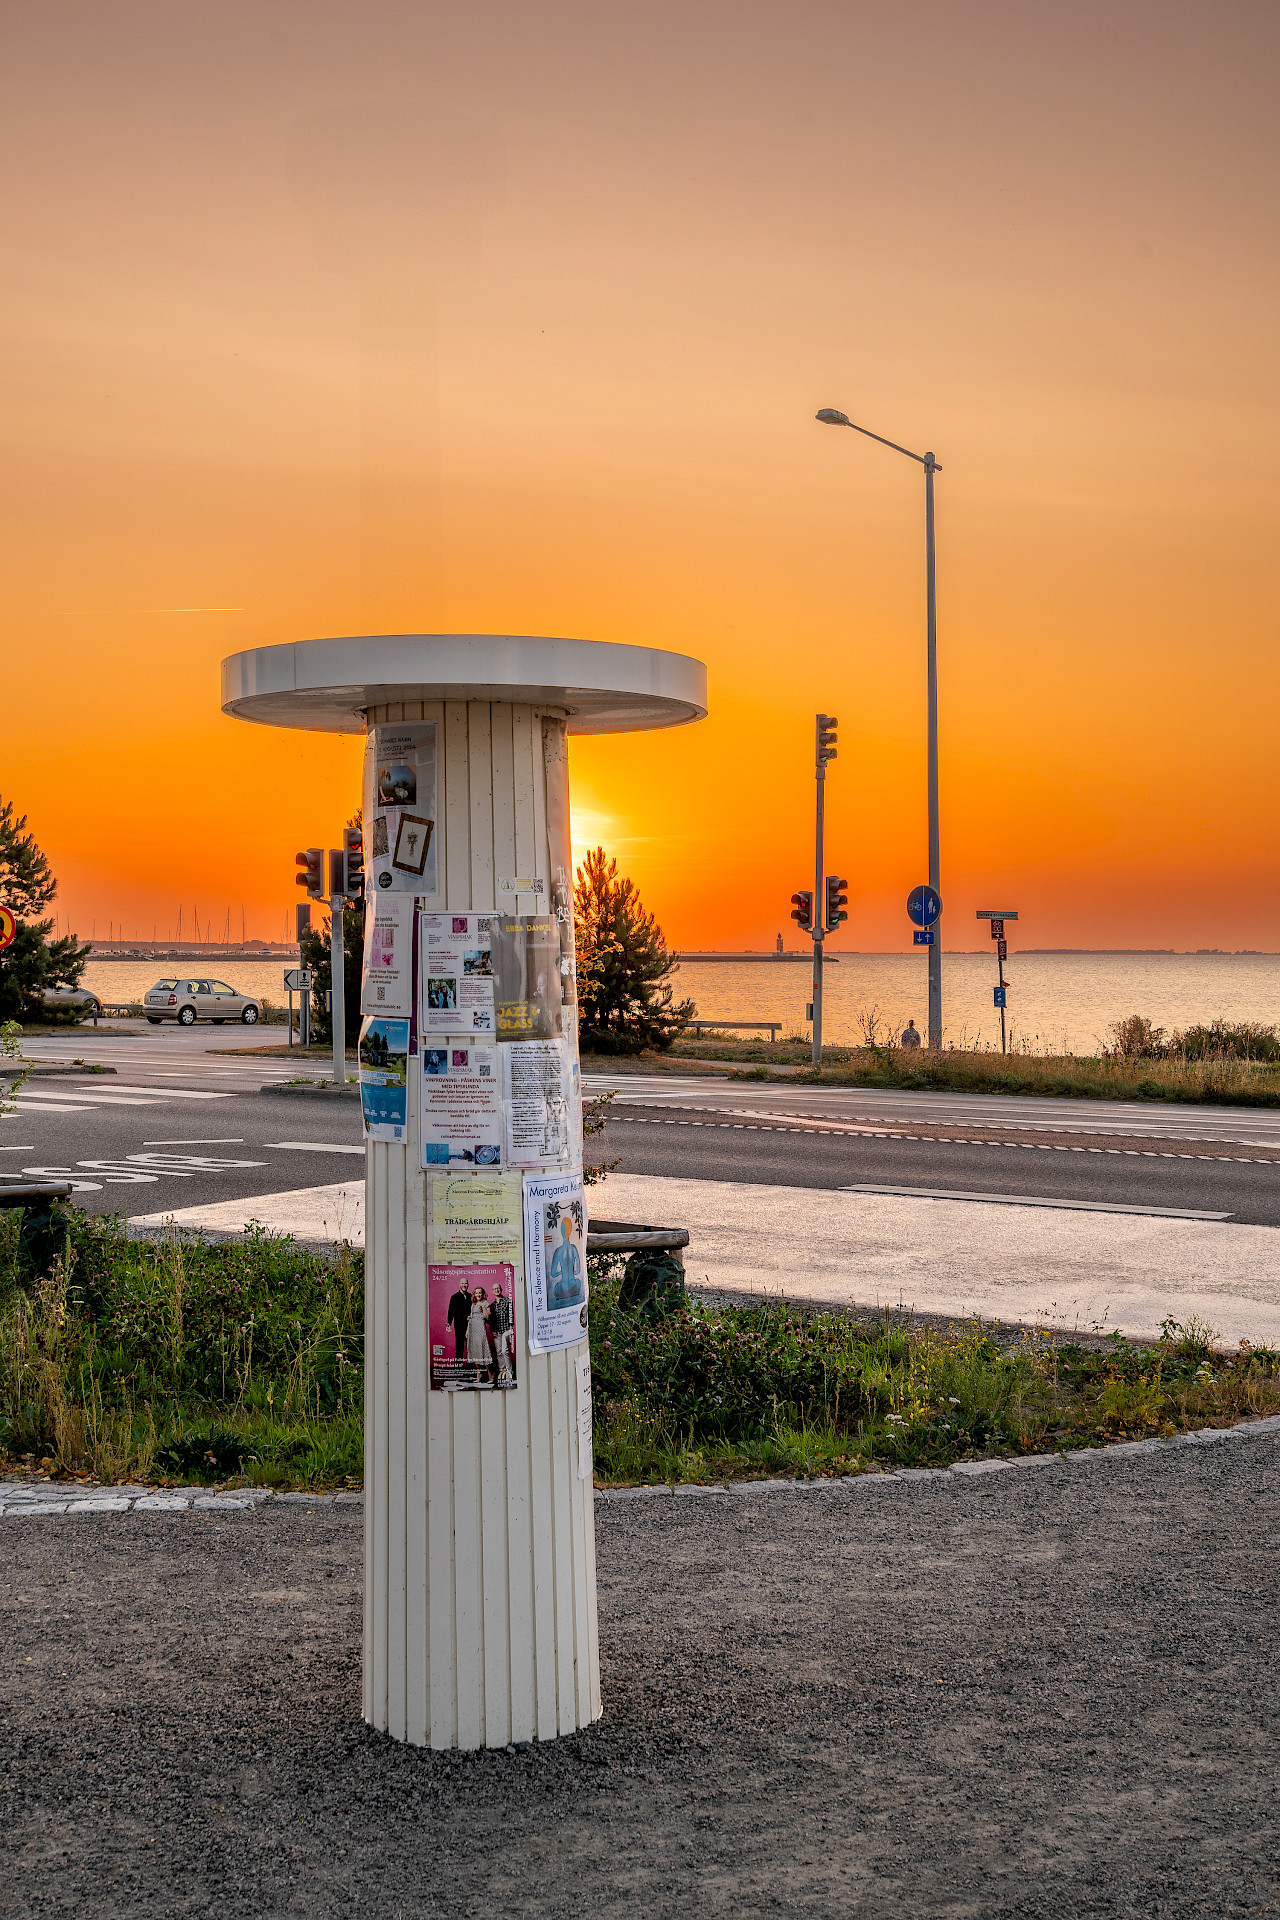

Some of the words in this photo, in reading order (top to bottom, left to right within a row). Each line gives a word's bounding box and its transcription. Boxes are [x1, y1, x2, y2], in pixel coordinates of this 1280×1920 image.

[497, 1006, 528, 1017] JAZZ
[498, 1018, 533, 1029] GLASS
[530, 1184, 568, 1198] Margareta
[445, 1217, 509, 1225] TRÄDGÅRDSHJÄLP
[534, 1267, 542, 1294] Silence
